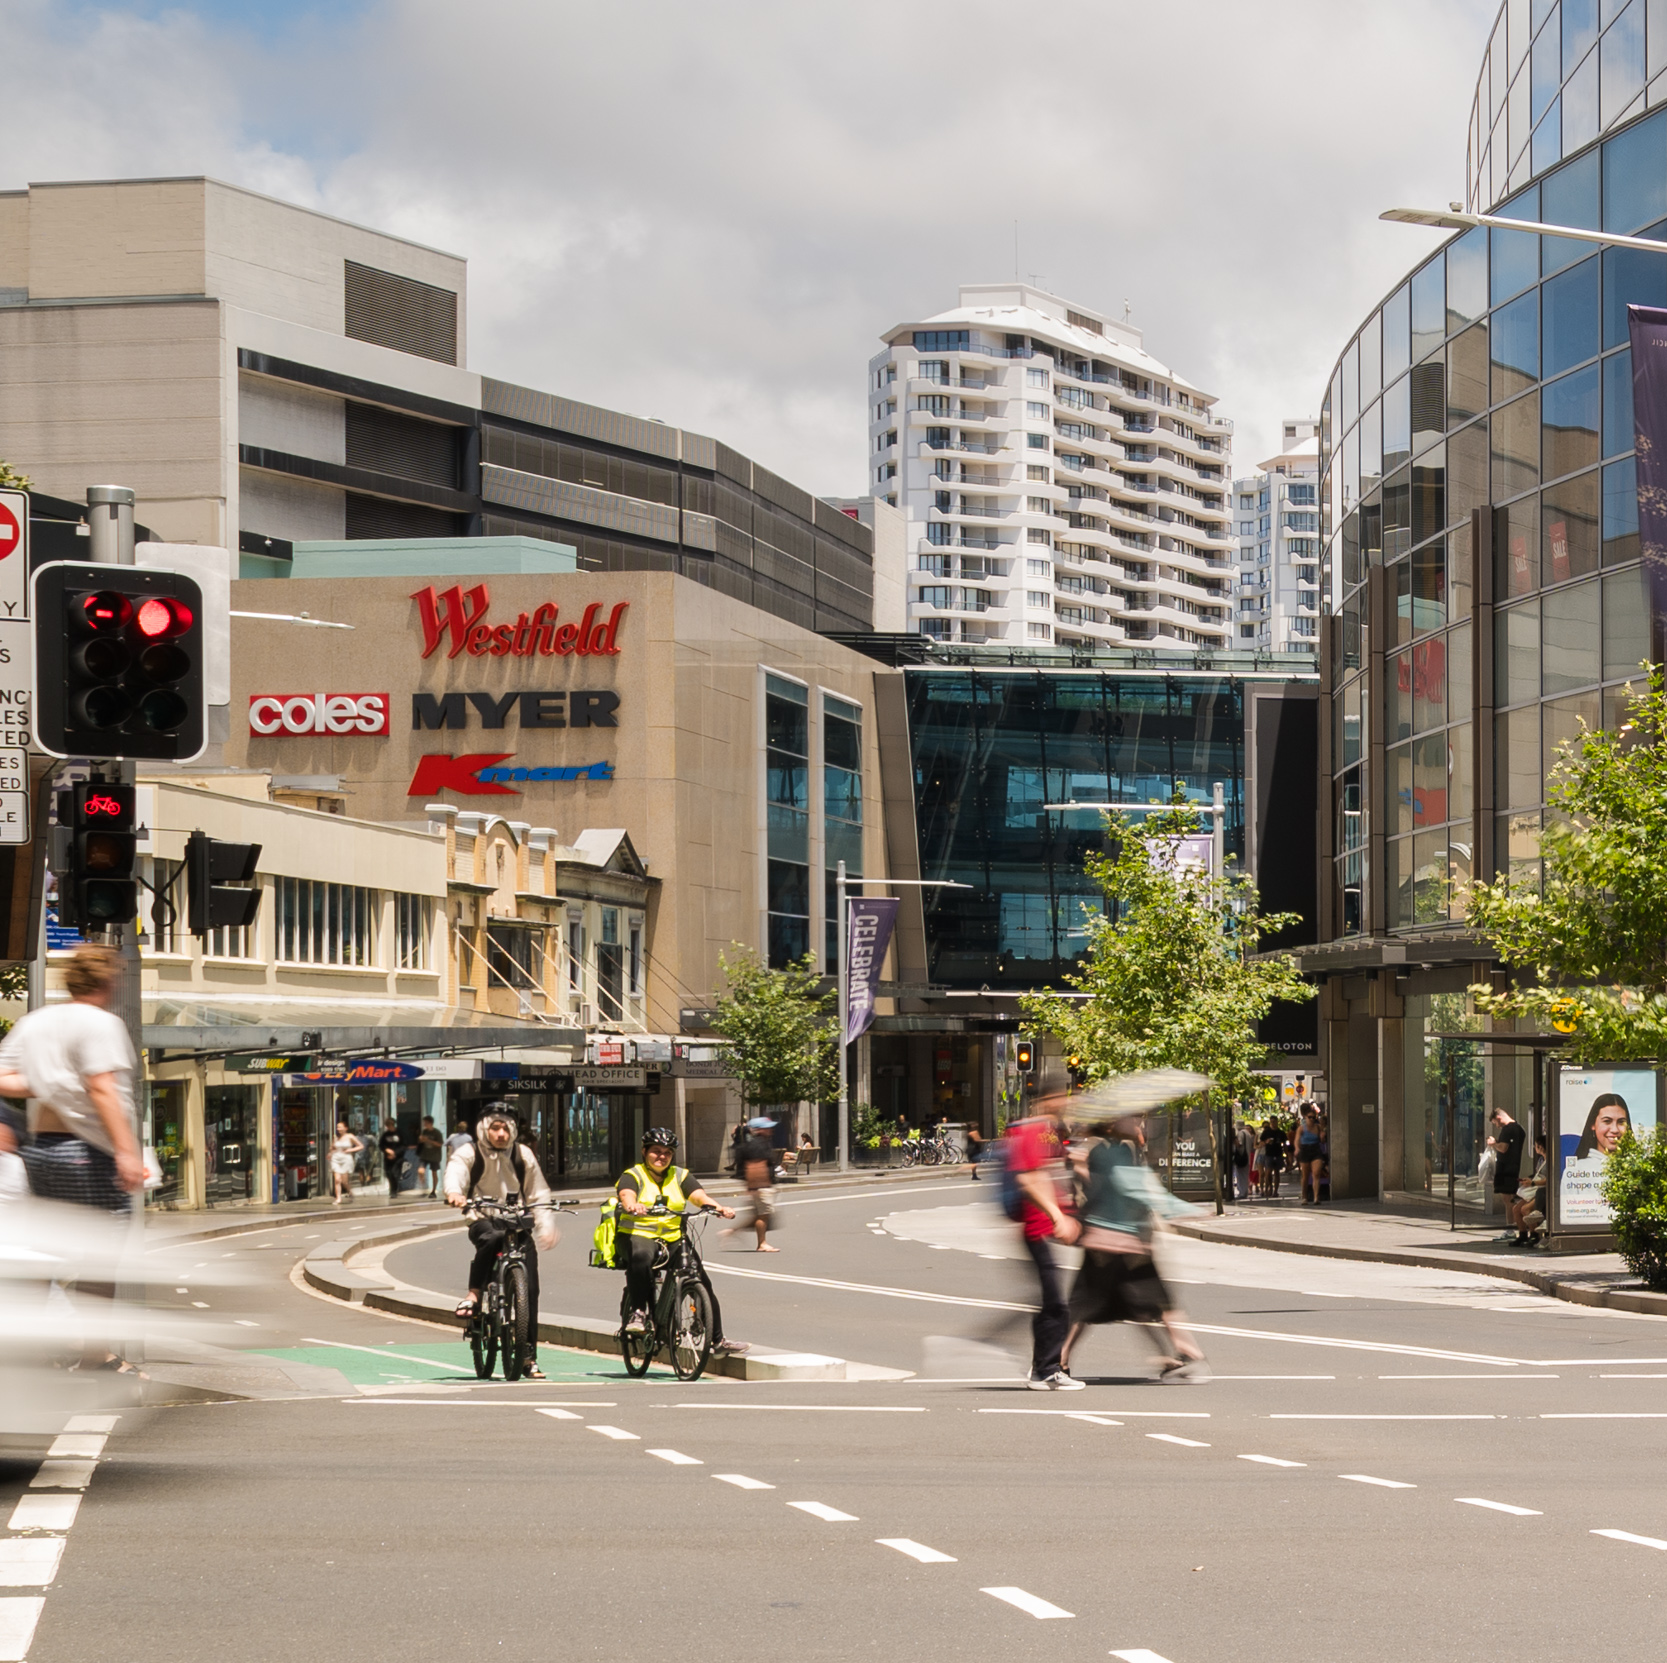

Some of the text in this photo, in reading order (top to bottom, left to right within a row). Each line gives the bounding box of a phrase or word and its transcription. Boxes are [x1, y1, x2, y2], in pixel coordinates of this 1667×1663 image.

[1552, 539, 1567, 559] SALE
[1514, 554, 1528, 573] SALE
[409, 583, 630, 659] Westfield
[249, 693, 386, 734] coles
[412, 690, 620, 730] MYER
[407, 753, 615, 796] Kmart
[849, 914, 879, 1011] CELEBRATE
[247, 1058, 289, 1069] SUBWAY
[567, 1069, 640, 1079] HEAD OFFICE
[508, 1080, 547, 1089] SIKSILK
[1175, 1142, 1195, 1150] YOU
[1158, 1158, 1211, 1167] DIFERENCE
[1566, 1170, 1590, 1178] Guide
[1566, 1182, 1592, 1191] shape
